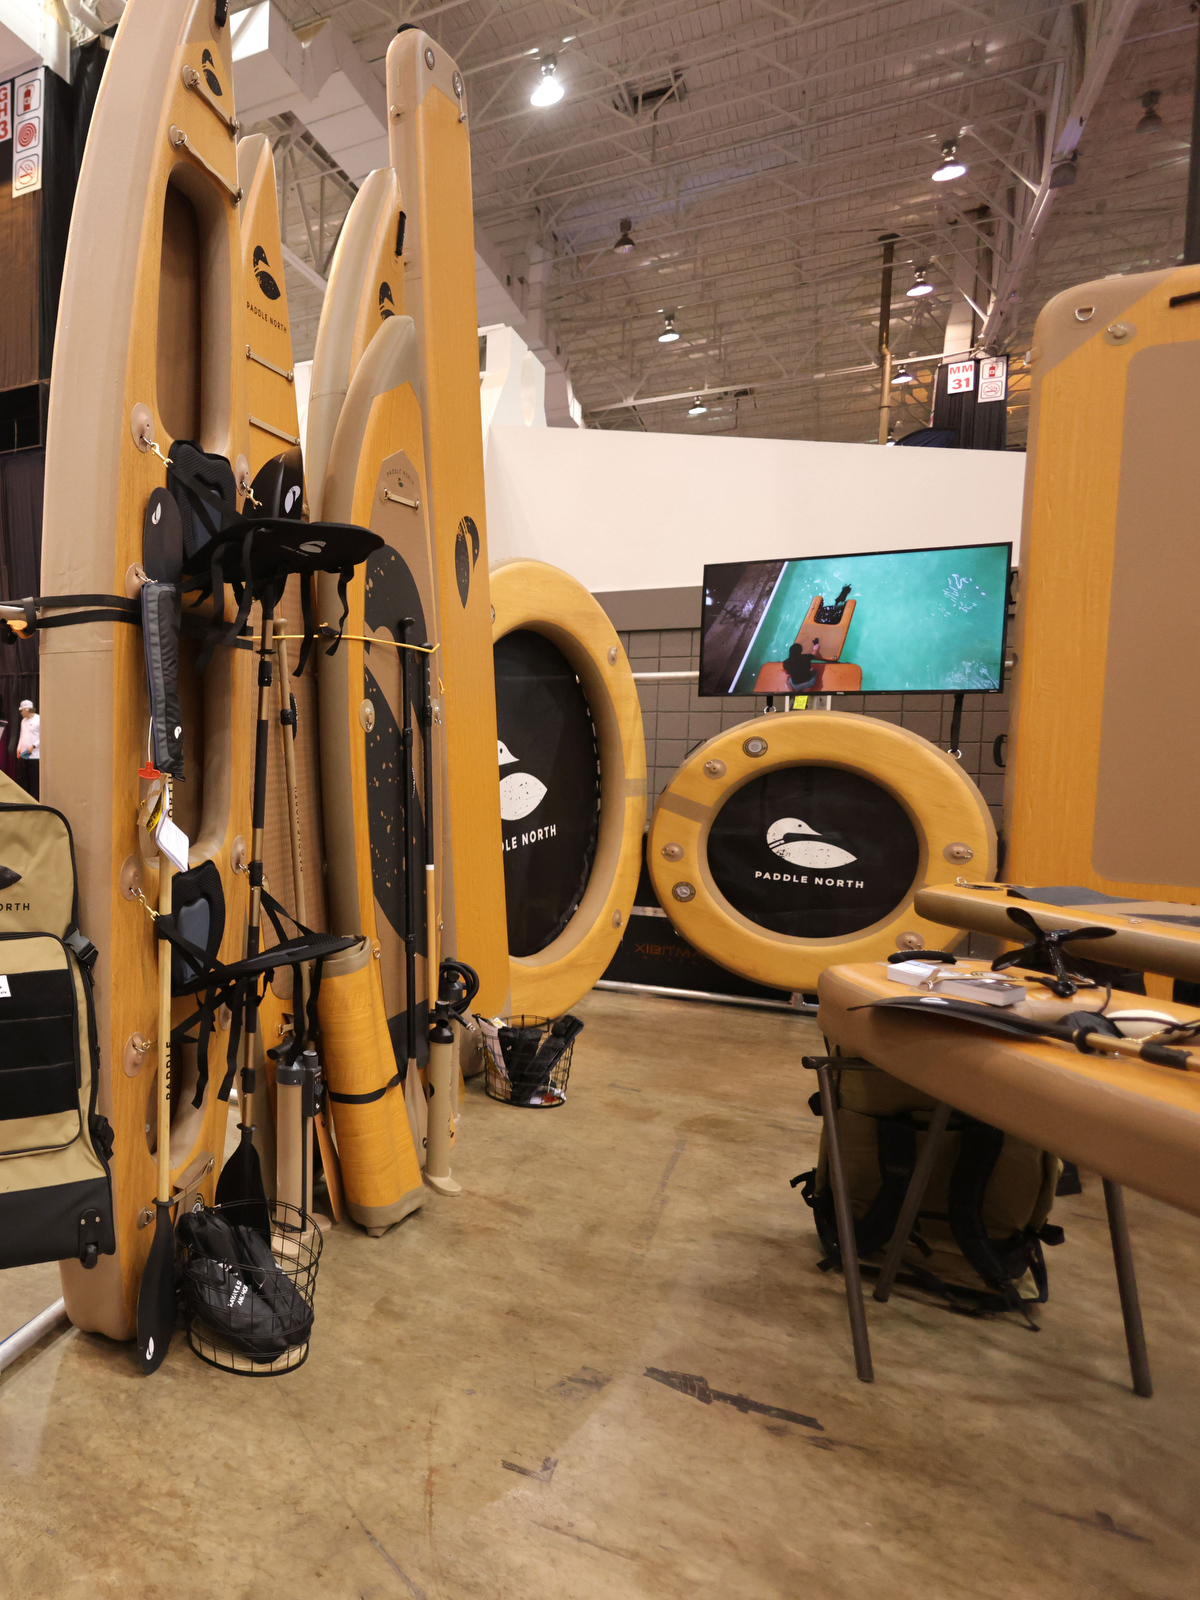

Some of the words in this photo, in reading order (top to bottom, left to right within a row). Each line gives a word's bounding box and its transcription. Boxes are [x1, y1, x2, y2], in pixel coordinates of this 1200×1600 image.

[246, 301, 268, 322] PADDLE
[269, 317, 287, 334] NORTH
[949, 364, 973, 375] MM
[952, 377, 970, 390] 31
[521, 824, 557, 846] NORTH
[754, 870, 808, 884] PADDLE
[814, 876, 865, 889] NORTH
